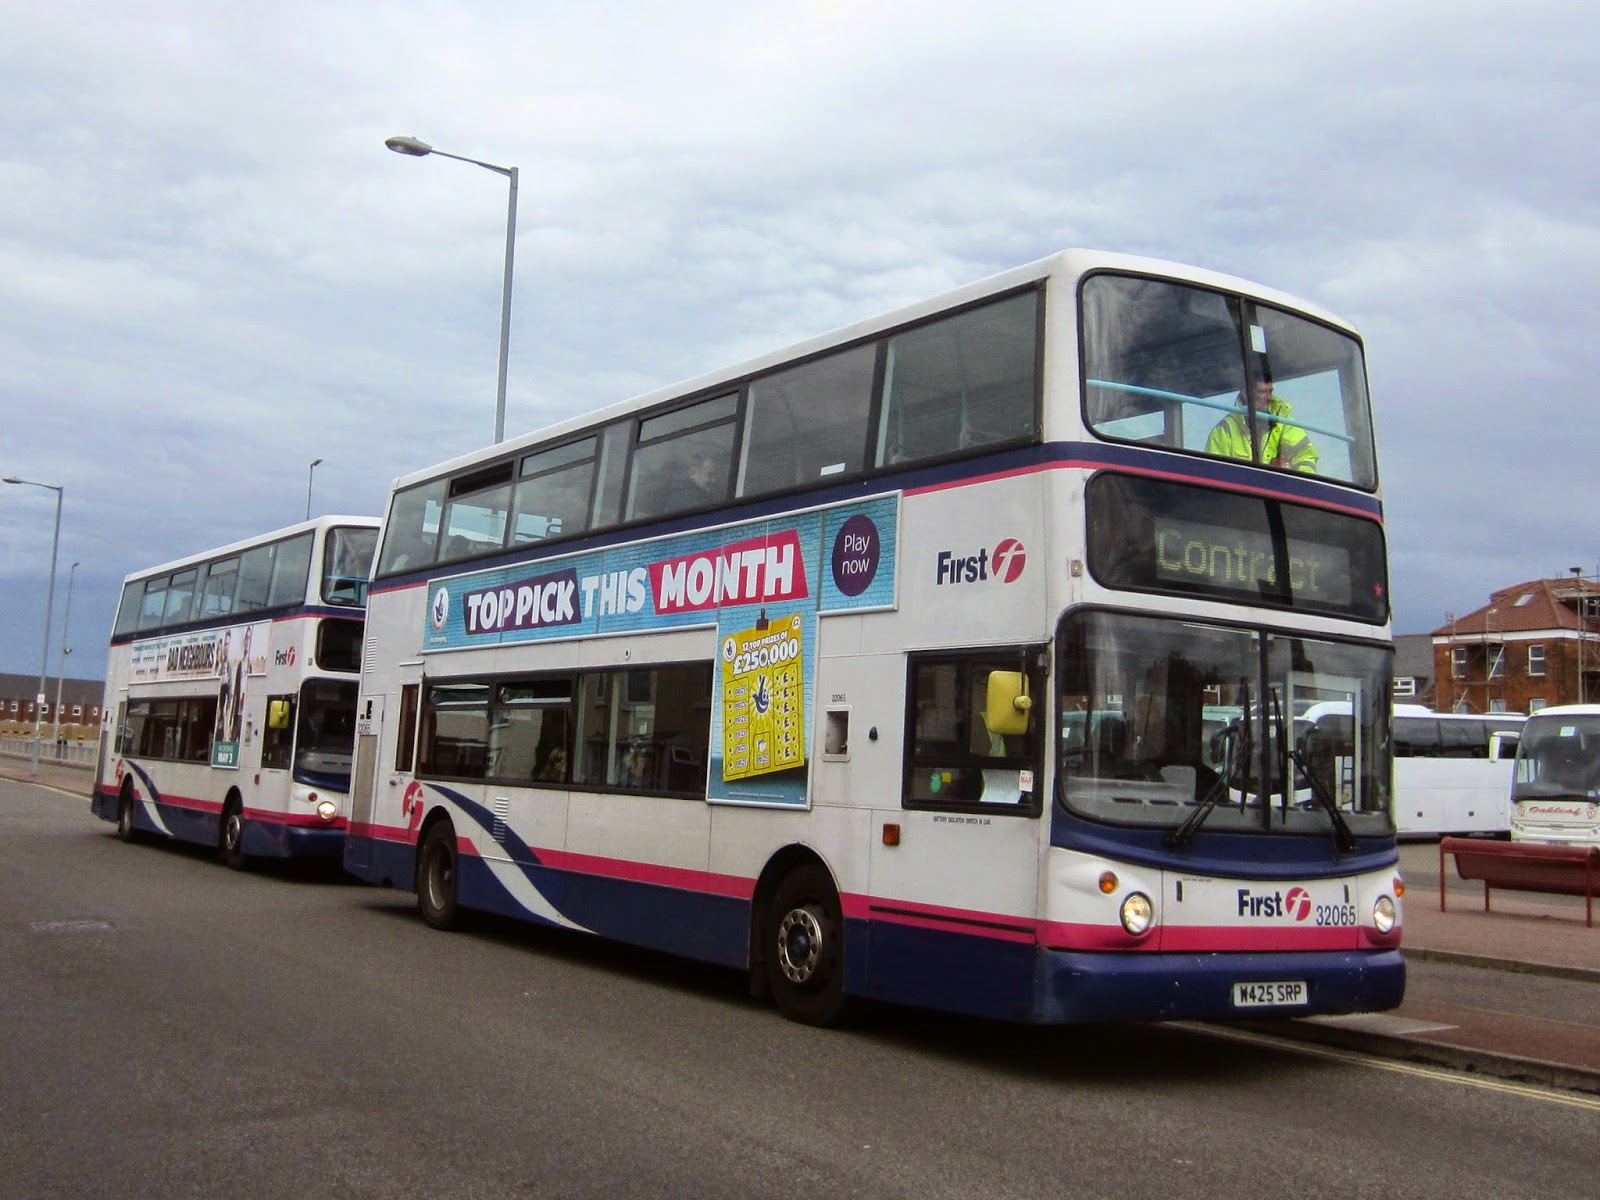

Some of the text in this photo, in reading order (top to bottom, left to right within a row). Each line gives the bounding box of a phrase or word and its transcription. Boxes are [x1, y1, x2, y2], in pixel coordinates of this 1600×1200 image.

[844, 533, 870, 555] Play
[1158, 528, 1319, 592] Contract
[841, 558, 870, 575] now
[937, 547, 989, 585] First
[467, 543, 794, 631] TOP PICK THIS MONTH
[734, 638, 798, 675] £250,000
[750, 640, 761, 649] TOP
[761, 633, 780, 646] PRIZES
[780, 630, 788, 640] OF
[1238, 889, 1356, 926] First 32065
[1240, 984, 1301, 1003] W425 SRP
